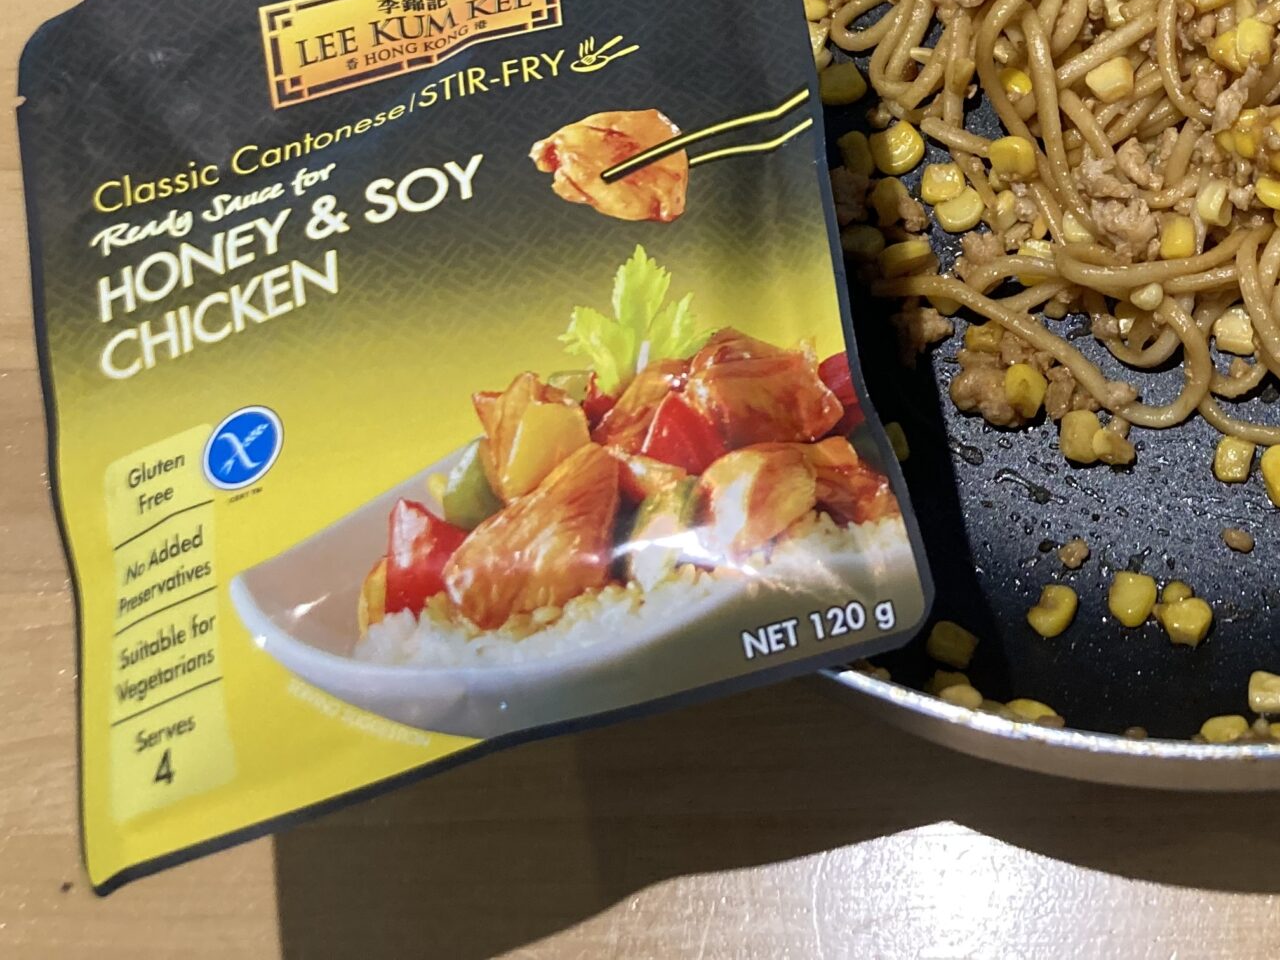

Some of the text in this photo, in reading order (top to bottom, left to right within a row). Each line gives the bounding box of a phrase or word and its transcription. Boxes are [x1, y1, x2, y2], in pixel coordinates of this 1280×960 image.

[296, 26, 358, 67] LEE
[369, 8, 459, 48] KUM
[364, 42, 418, 67] HONG
[423, 25, 469, 53] KONG
[89, 162, 337, 257] Ready Sauce for
[93, 160, 221, 213] Classic
[98, 154, 484, 324] HONEY & SOY
[100, 249, 339, 380] CHICKEN
[127, 454, 185, 489] Gluten
[138, 485, 174, 515] Free
[125, 523, 203, 585] No Added
[118, 561, 212, 617] Preservatives
[118, 614, 216, 670] Suitable for
[742, 600, 896, 659] NET 120 g
[115, 648, 215, 703] Vegetarians
[136, 715, 196, 753] Serves
[153, 748, 176, 785] 4
